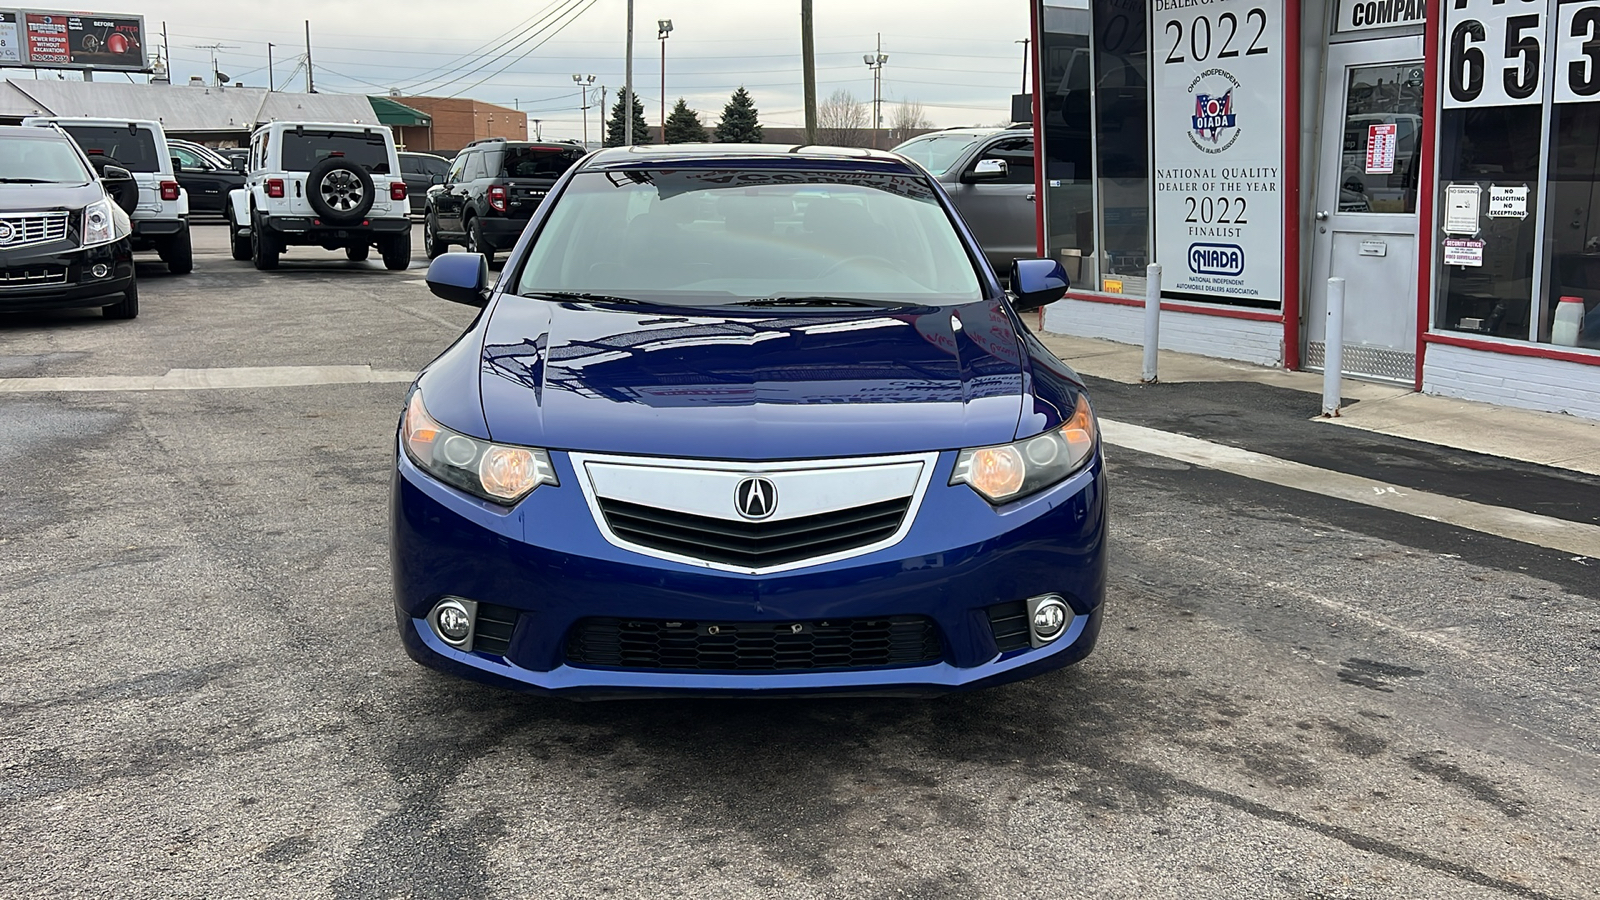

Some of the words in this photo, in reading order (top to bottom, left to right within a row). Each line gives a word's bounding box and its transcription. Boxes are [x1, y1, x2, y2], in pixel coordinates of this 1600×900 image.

[115, 25, 139, 33] AFTER
[1164, 7, 1269, 65] 2022
[1187, 75, 1201, 93] OHIO
[1201, 68, 1241, 89] INDEPENDENT
[1197, 115, 1229, 129] OIADA
[1187, 130, 1205, 153] AUTOMOBILE
[1221, 128, 1242, 152] ASSOCIATION
[1157, 168, 1217, 179] NATIONAL
[1221, 167, 1278, 180] QUALITY
[1158, 182, 1198, 191] DEALER
[1202, 182, 1216, 191] OF
[1220, 182, 1242, 191] THE
[1246, 182, 1276, 192] YEAR
[1184, 196, 1248, 224] 2022
[1188, 226, 1242, 238] FINALIST
[1192, 249, 1239, 270] NIADA
[1188, 275, 1212, 284] NATIONAL
[1212, 278, 1245, 286] INDEPENDENT
[1176, 283, 1204, 291] AUTOMOBILE
[1205, 285, 1225, 293] DEALERS
[1225, 287, 1259, 295] ASSOCIATION
